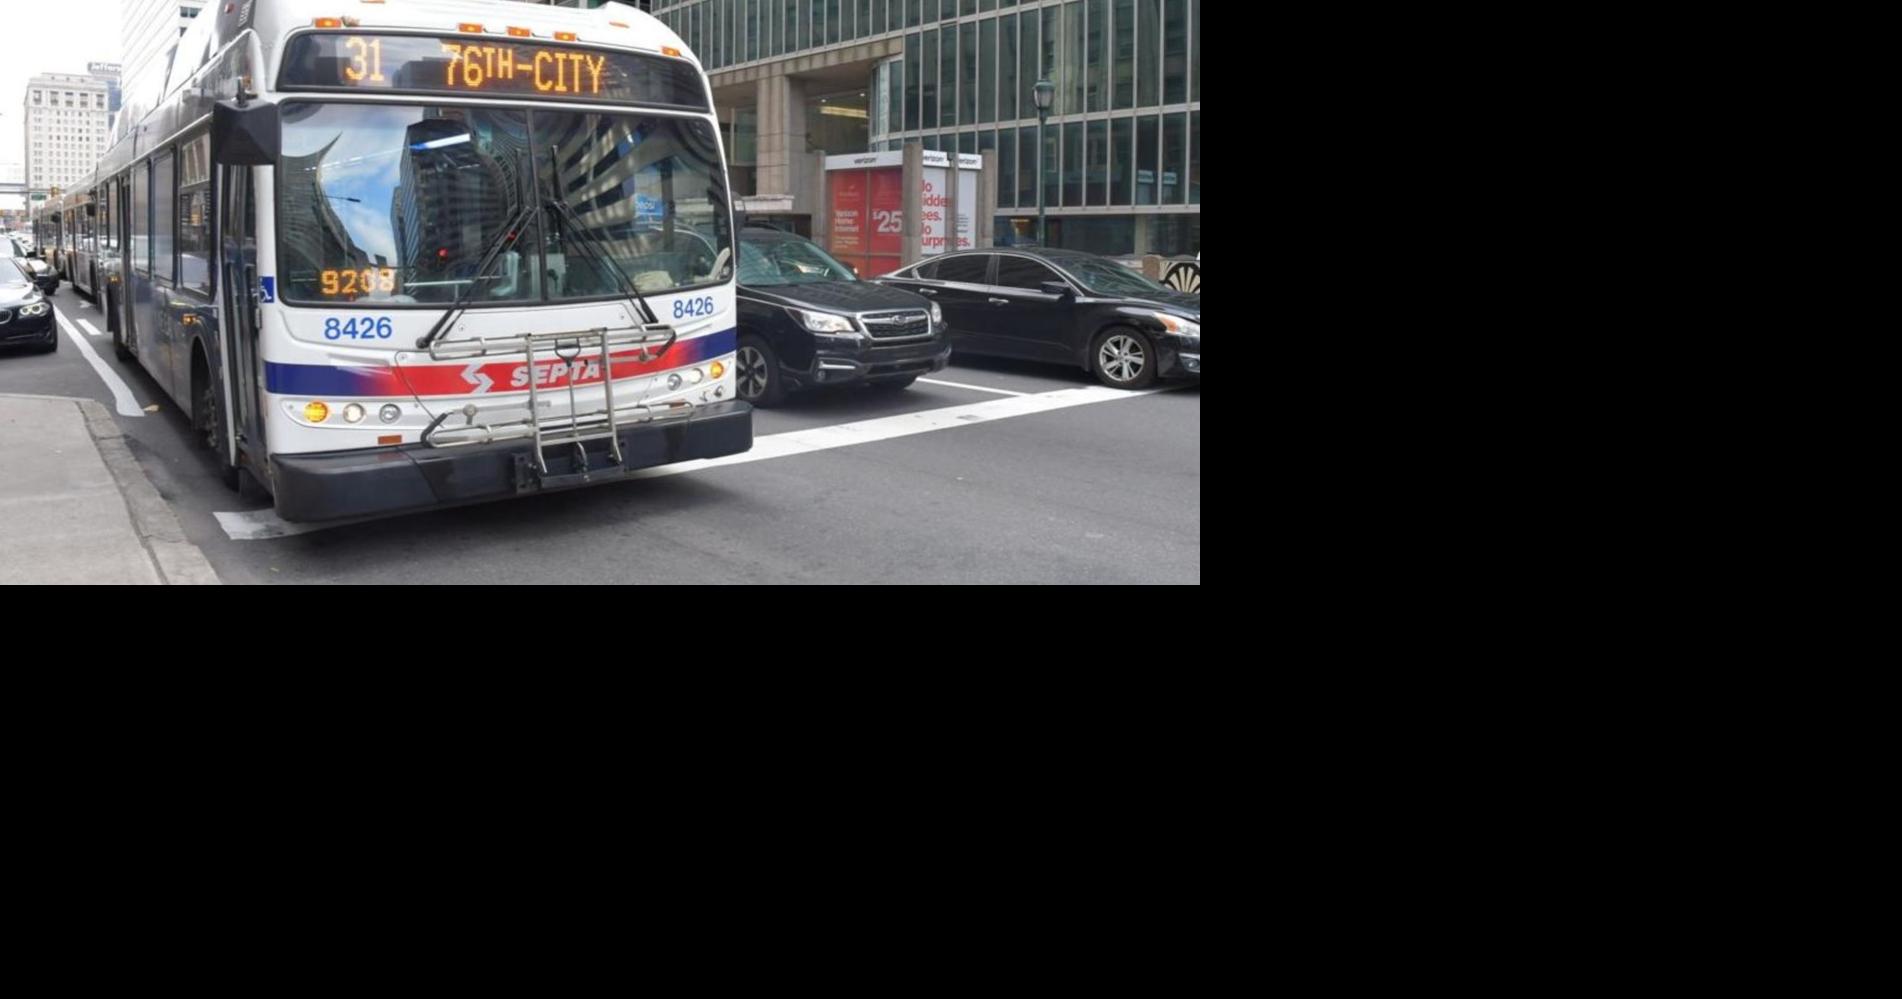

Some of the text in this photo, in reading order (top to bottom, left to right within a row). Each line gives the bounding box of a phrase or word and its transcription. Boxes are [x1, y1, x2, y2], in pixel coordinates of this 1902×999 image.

[345, 37, 605, 94] 31 76TH-CITY
[872, 208, 903, 233] $25
[321, 267, 396, 295] 9208
[673, 296, 714, 319] 8426
[324, 316, 393, 340] 8426
[510, 360, 601, 387] SEPTA
